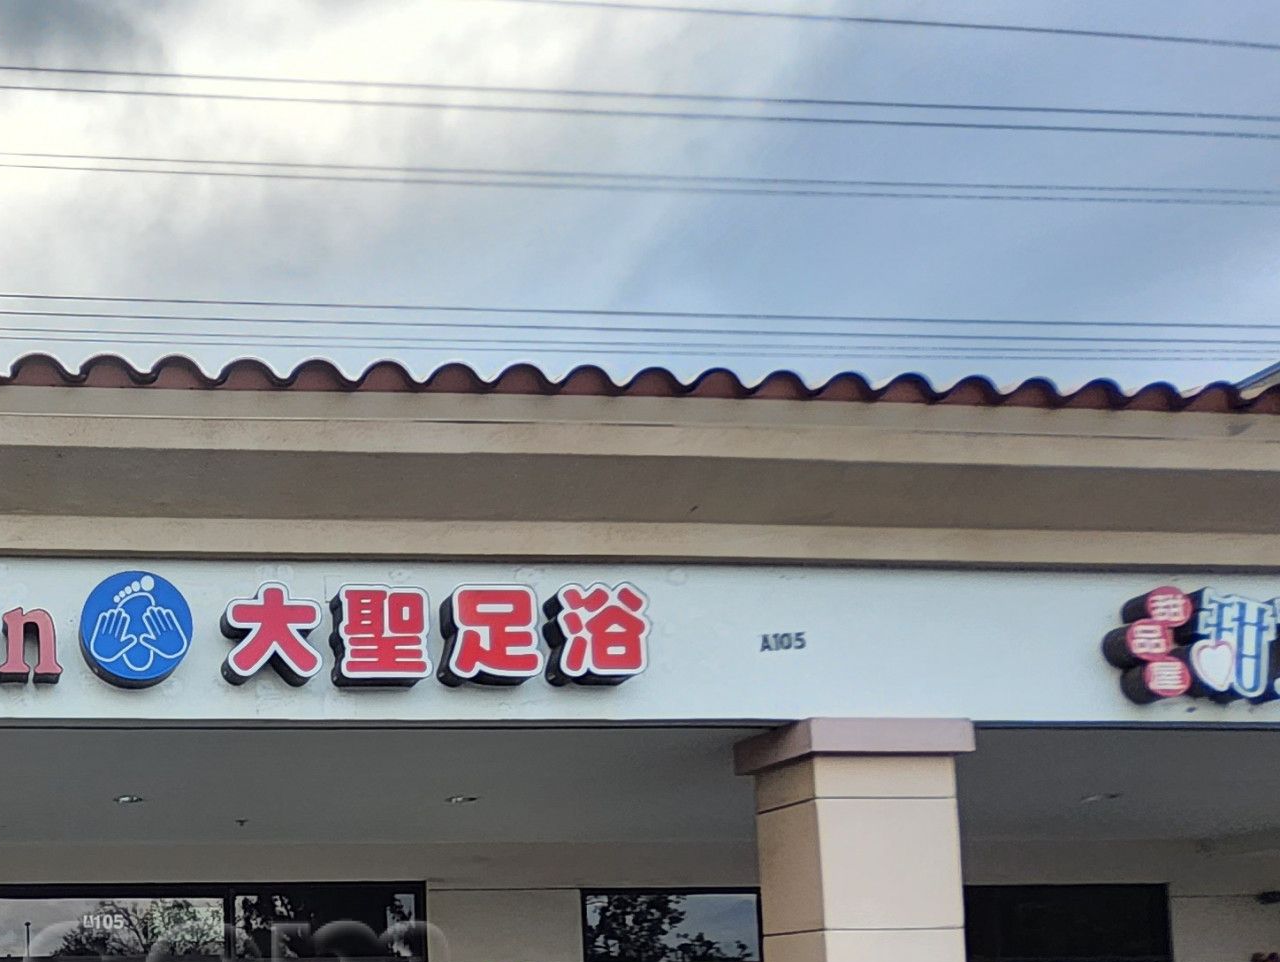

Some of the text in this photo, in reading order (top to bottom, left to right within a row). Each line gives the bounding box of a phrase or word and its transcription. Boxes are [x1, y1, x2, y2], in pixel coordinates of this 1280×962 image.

[221, 581, 651, 688] 大聖足浴
[760, 631, 807, 652] A105
